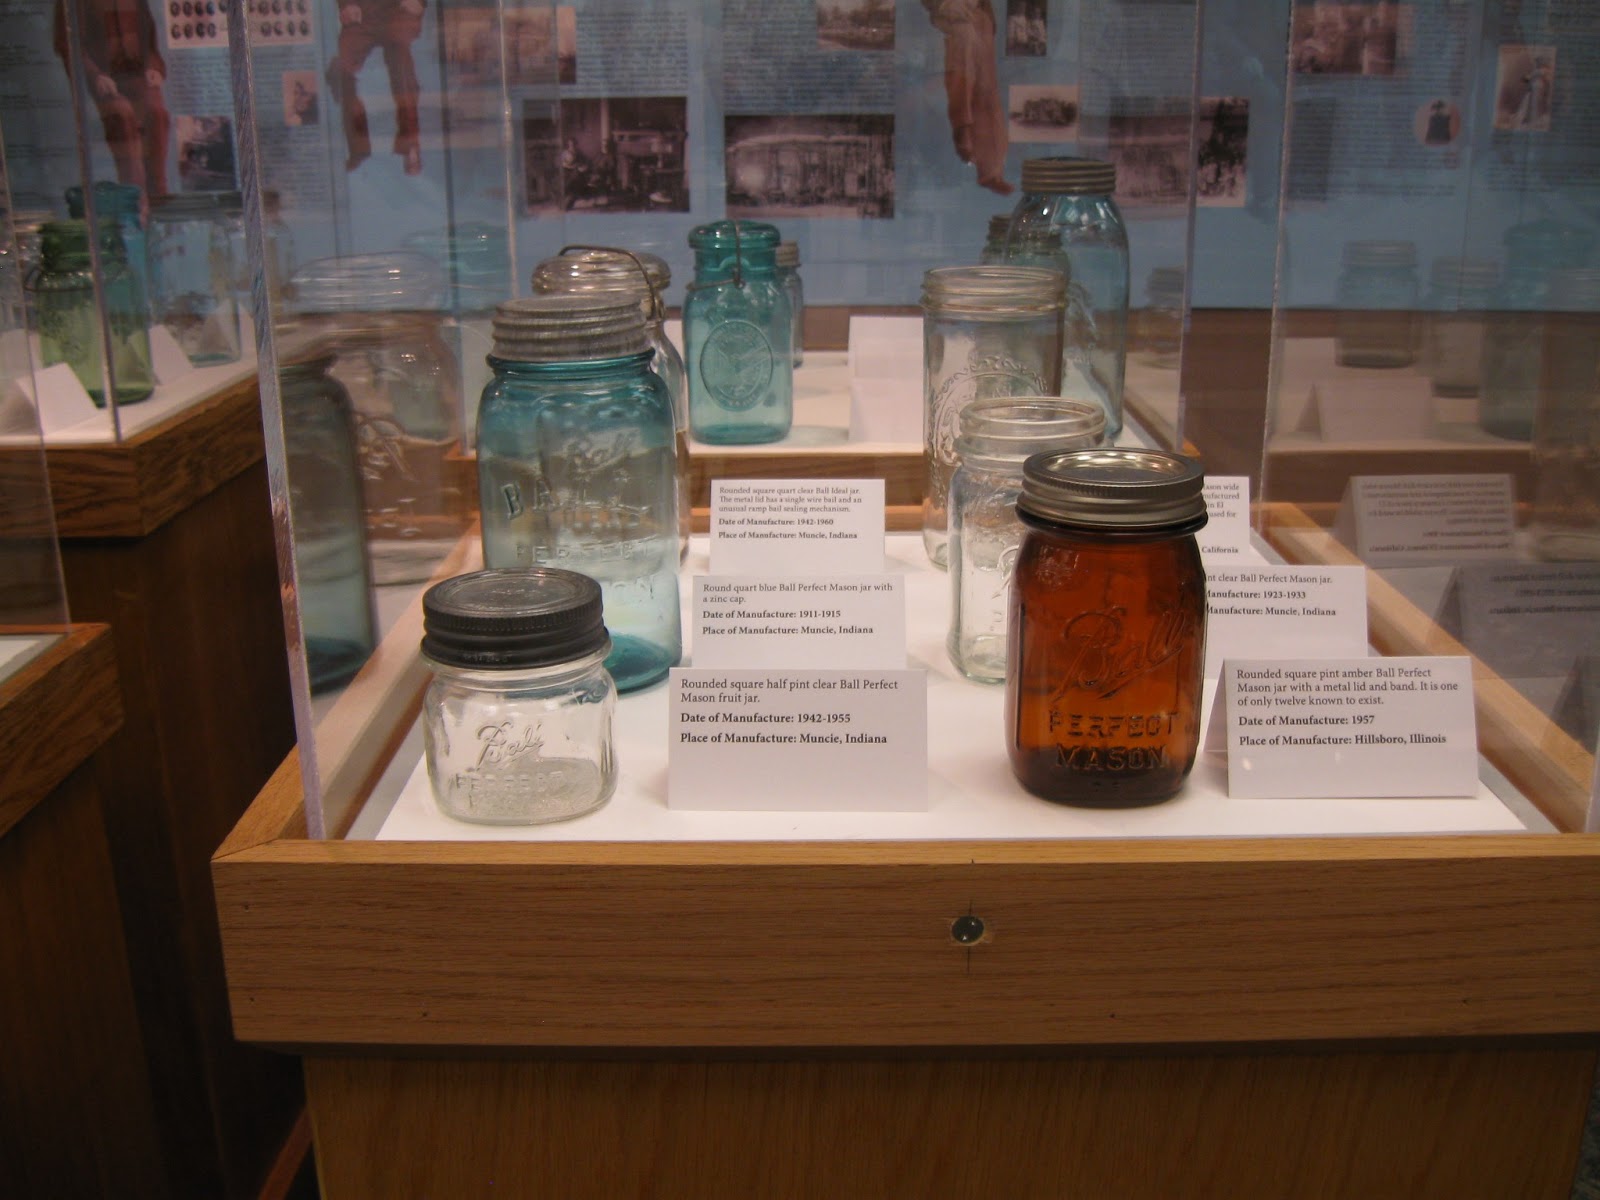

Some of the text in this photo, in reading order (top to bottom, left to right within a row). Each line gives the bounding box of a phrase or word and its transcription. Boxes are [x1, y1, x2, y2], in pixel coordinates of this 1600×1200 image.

[776, 487, 796, 496] quart
[849, 487, 860, 496] jar.
[784, 496, 805, 505] single
[783, 506, 808, 514] sealing
[798, 532, 828, 540] Muncie,
[1201, 546, 1239, 554] California
[1218, 573, 1238, 582] clear
[1240, 574, 1257, 582] Ball
[1259, 574, 1288, 583] Perfect
[1289, 575, 1318, 583] Mason
[1319, 575, 1333, 585] jar.
[733, 584, 757, 594] quart
[860, 584, 872, 594] jar
[729, 596, 746, 604] cap.
[801, 627, 837, 636] Muncie,
[1054, 605, 1186, 701] Ball
[1237, 668, 1432, 681] Rounded square pint amber Ball Perfect
[681, 679, 898, 693] Rounded square half pint clear Ball Perfect
[1237, 684, 1271, 692] Mason
[1273, 683, 1287, 694] jar
[1290, 683, 1313, 692] with
[1323, 683, 1351, 692] metal
[1353, 683, 1367, 691] lid
[1369, 682, 1388, 691] and
[1390, 682, 1417, 691] band.
[1420, 682, 1428, 691] It
[1430, 682, 1439, 691] is
[681, 693, 760, 705] Mason fruit jar.
[1237, 696, 1384, 708] of only twelve known to exist.
[681, 713, 851, 723] Date of Manufacture: 1942-1955
[1239, 716, 1375, 725] Date of Manufacture: 1957
[1049, 710, 1178, 737] PERFECT
[681, 734, 887, 745] Place of Manufacture: Muncie, Indiana
[1239, 735, 1447, 745] Place of Manufacture: Hillsboro, Illinois
[474, 720, 546, 771] Ball
[1055, 743, 1169, 770] MASON
